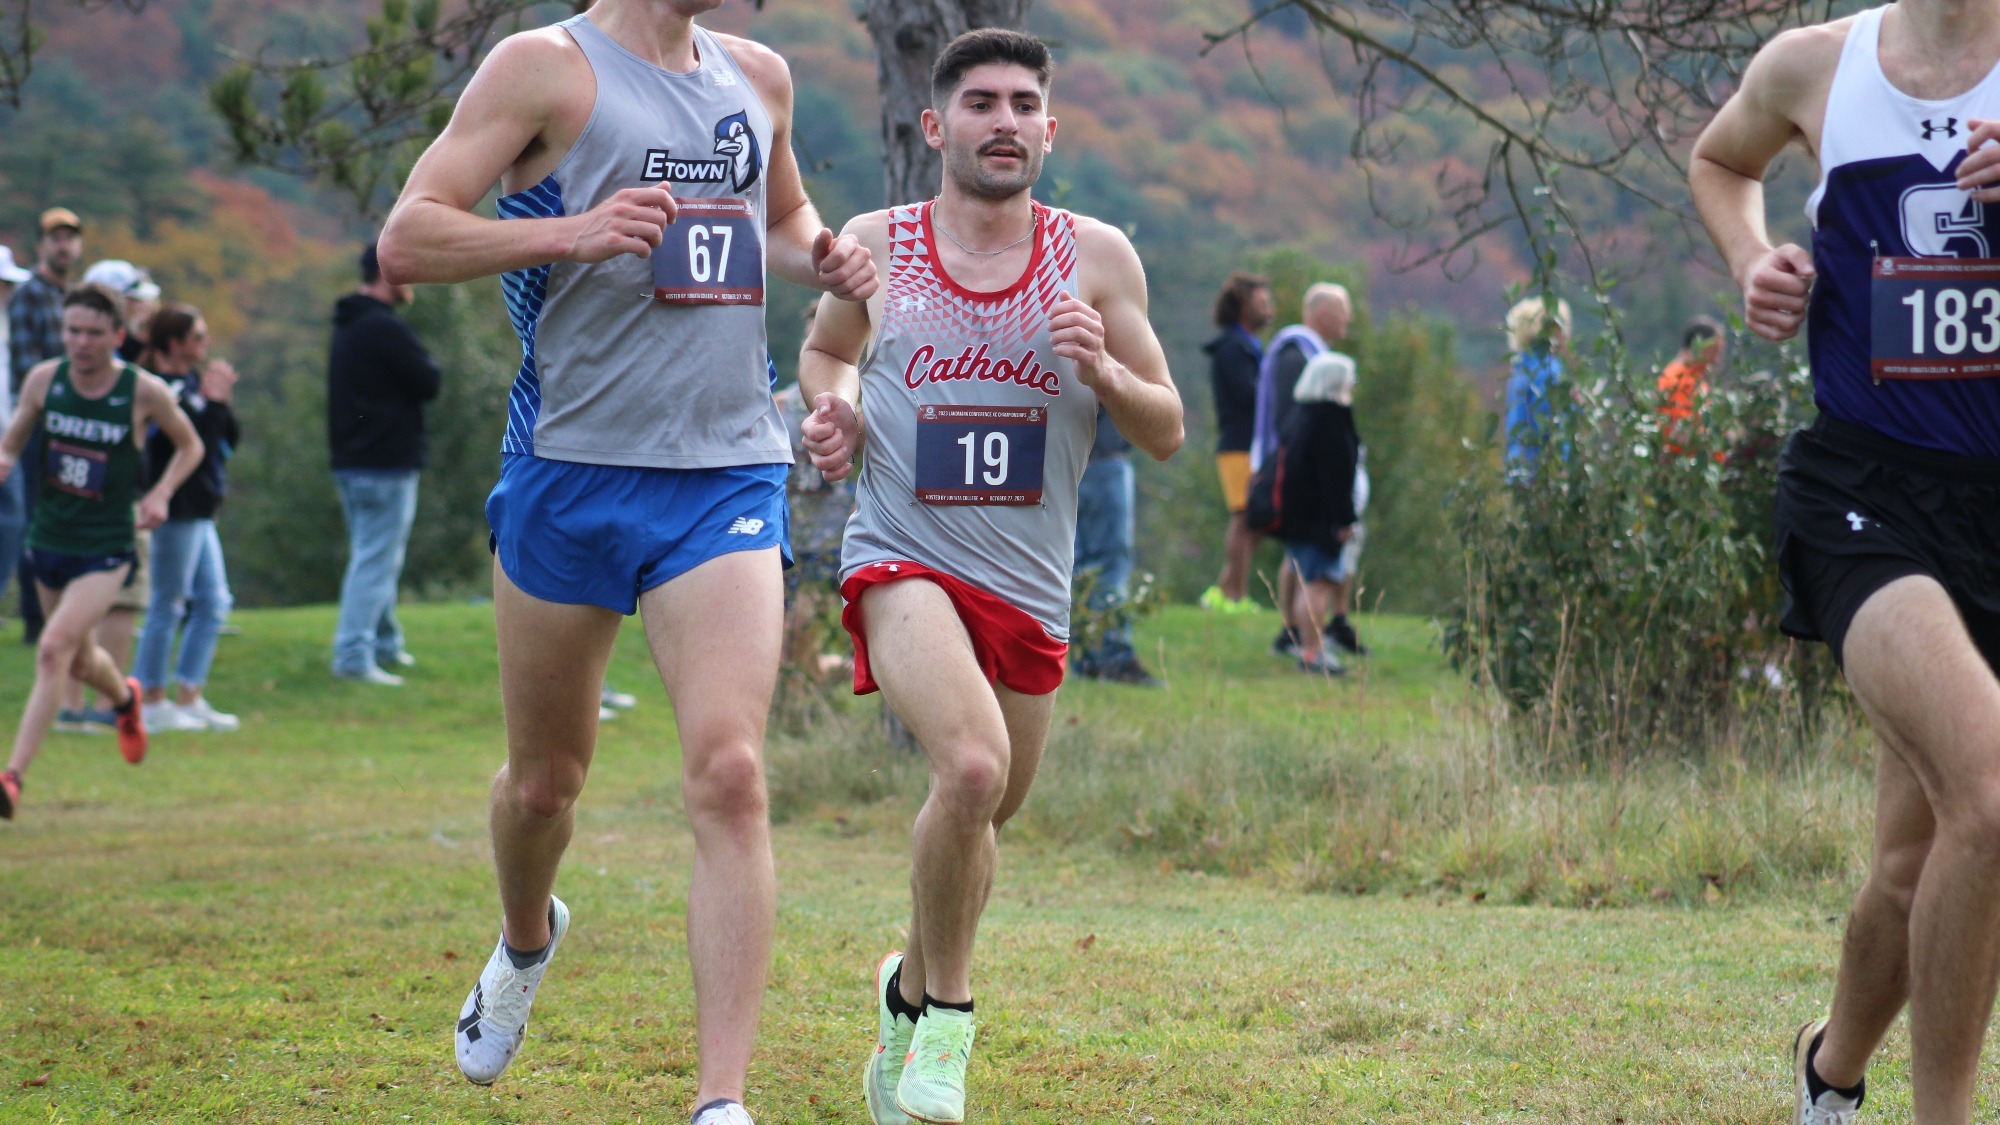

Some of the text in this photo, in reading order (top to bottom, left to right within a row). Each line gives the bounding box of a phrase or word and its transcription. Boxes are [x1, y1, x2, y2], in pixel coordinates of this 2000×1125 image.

[688, 224, 733, 283] 67
[1902, 288, 2000, 354] 183
[904, 342, 1060, 396] Catholic
[46, 410, 129, 444] DREW
[59, 454, 91, 489] 38
[957, 431, 1009, 486] 19
